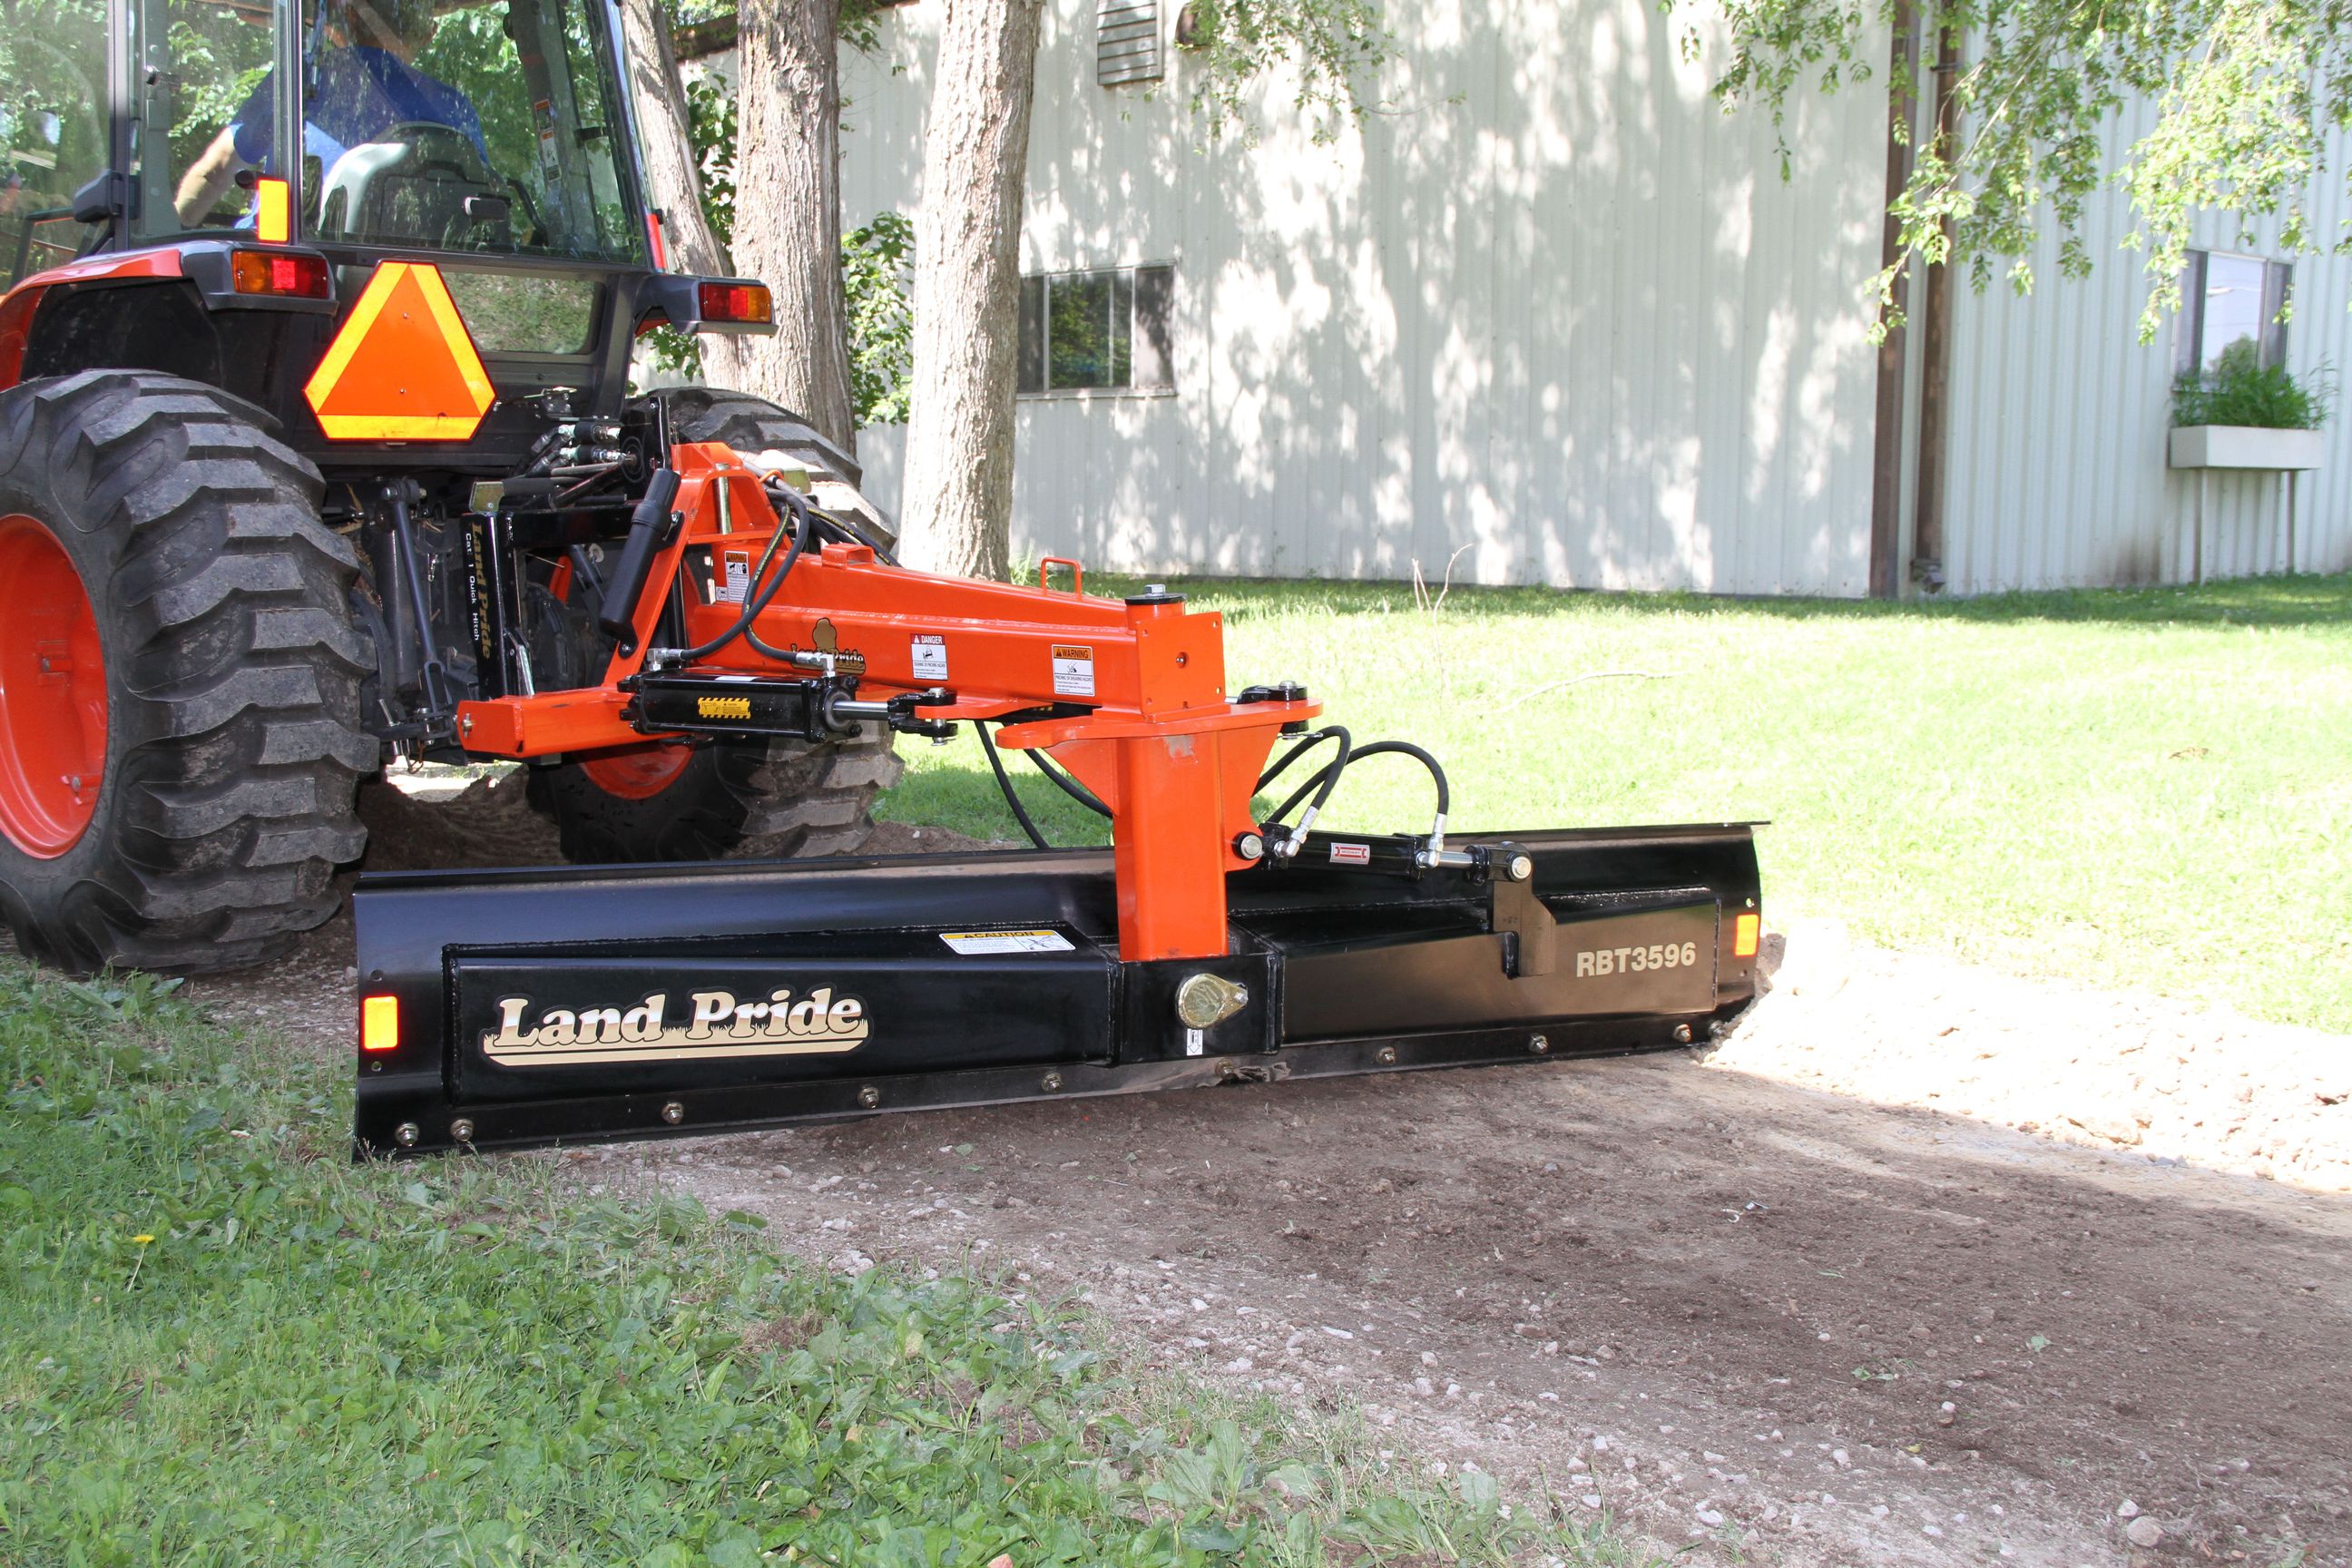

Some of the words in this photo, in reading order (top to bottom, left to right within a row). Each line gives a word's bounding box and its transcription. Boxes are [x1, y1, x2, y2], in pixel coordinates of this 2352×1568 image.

[472, 522, 487, 586] Land
[472, 612, 480, 641] Hitch
[478, 592, 492, 660] Pride
[921, 635, 943, 644] DANGER
[1062, 649, 1089, 659] WARNING
[1576, 942, 1696, 977] RBT3596
[493, 994, 666, 1047] Land
[686, 987, 862, 1040] Pride
